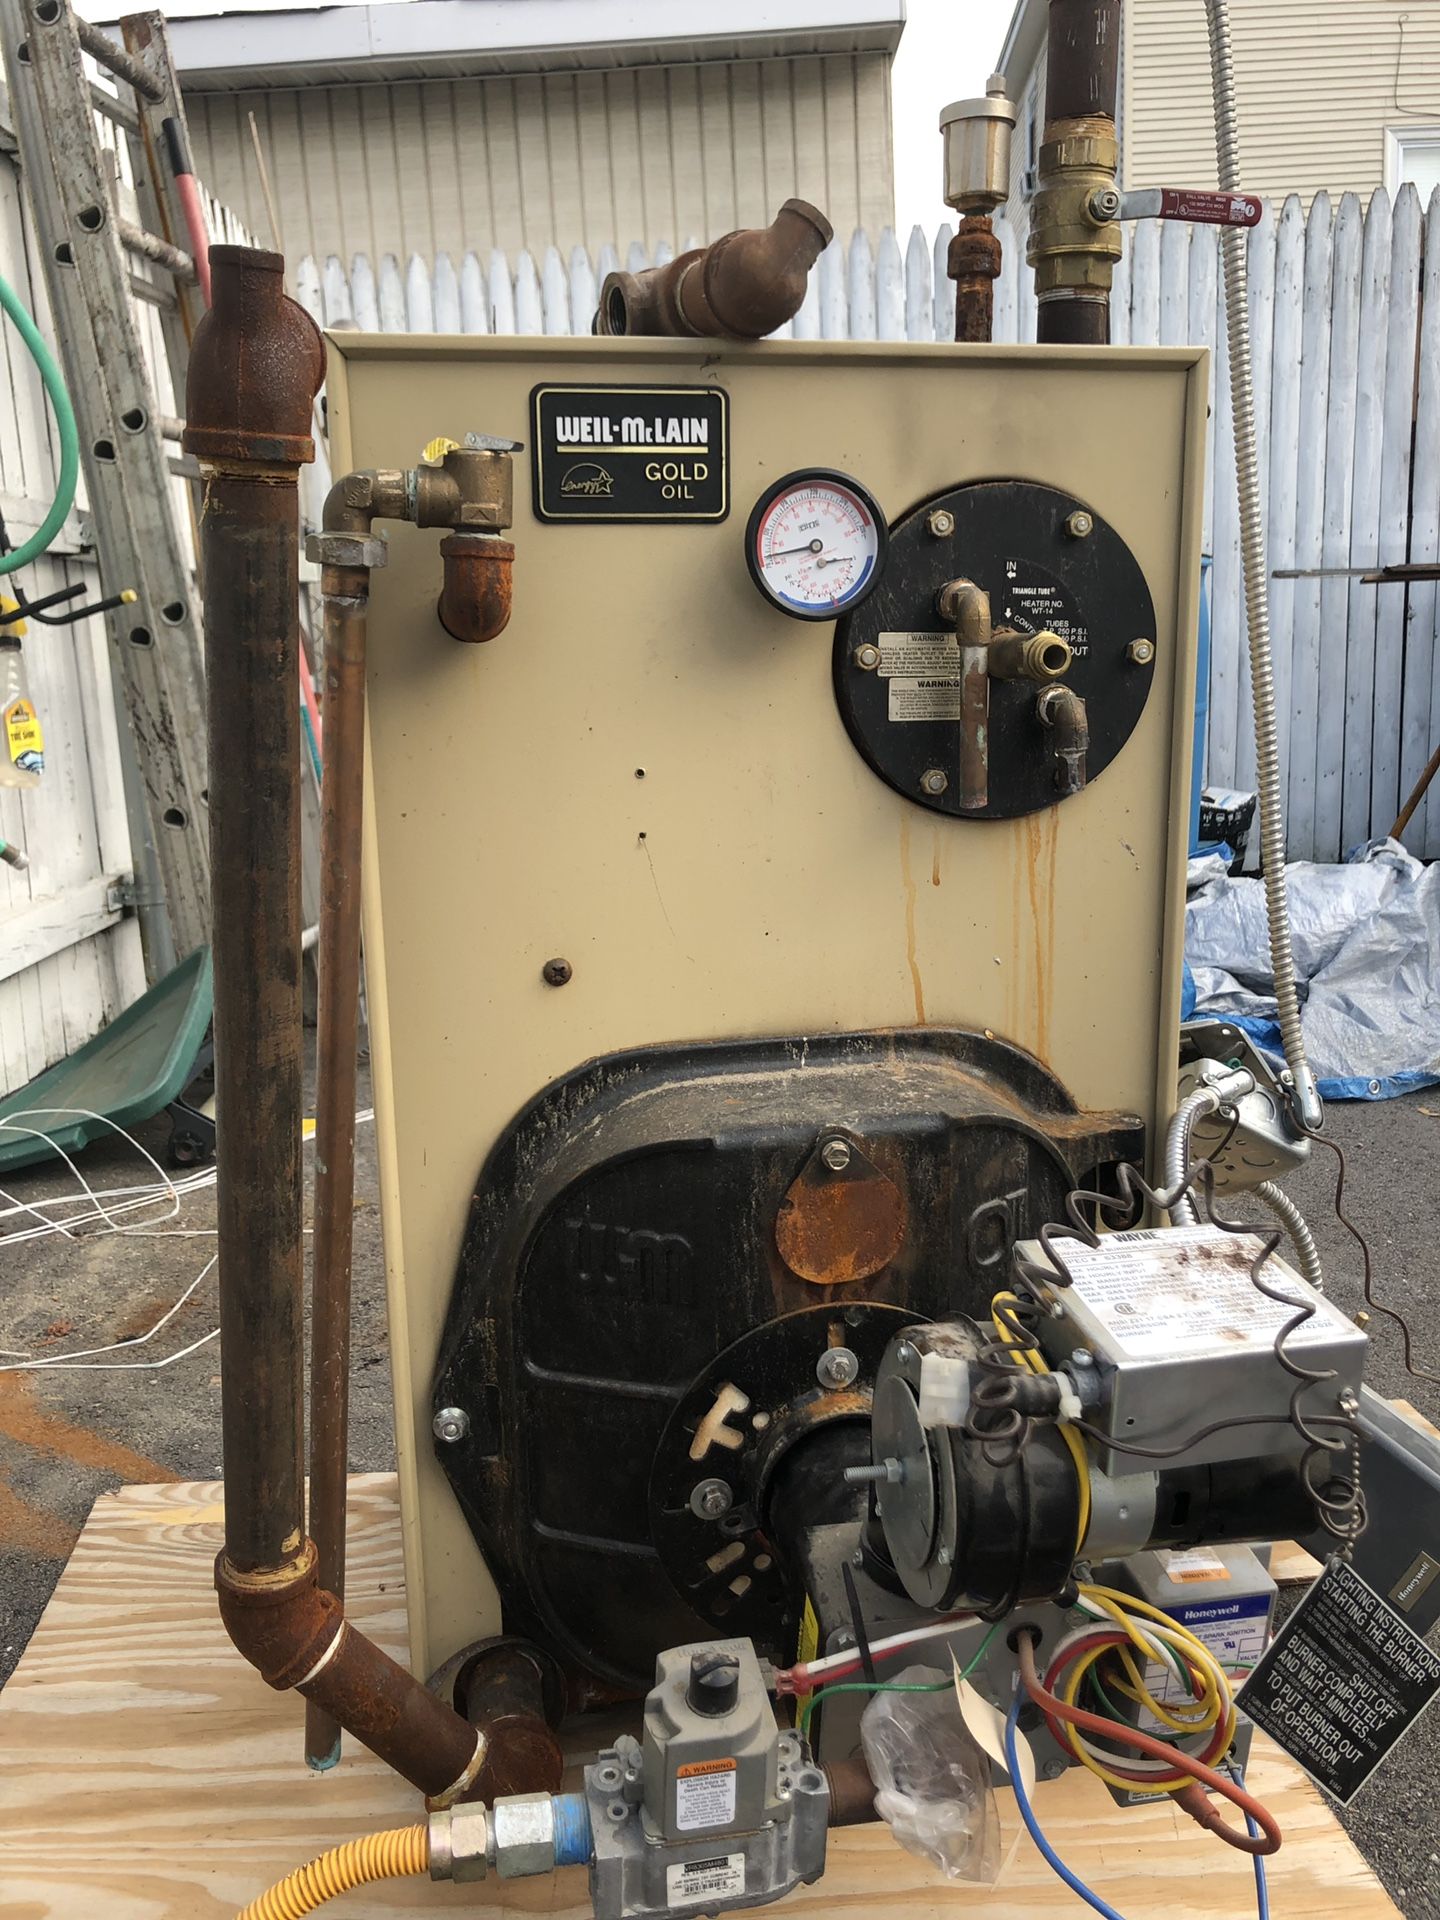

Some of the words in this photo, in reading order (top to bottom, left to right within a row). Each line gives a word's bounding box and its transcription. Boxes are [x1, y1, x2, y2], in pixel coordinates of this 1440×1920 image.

[645, 462, 708, 481] GOLD
[661, 484, 694, 499] OIL
[1006, 561, 1017, 570] IN
[1012, 587, 1037, 595] TRIANGLE
[1051, 600, 1064, 608] NO.
[917, 680, 960, 688] WARNING
[1112, 1231, 1159, 1242] WAYNE
[1397, 1562, 1431, 1602] Honeywell
[1184, 1605, 1240, 1620] Honeywell
[1332, 1564, 1376, 1612] LIGHTING
[1372, 1606, 1440, 1679] INSTRUCTIONS
[1203, 1632, 1225, 1640] SPARK
[1226, 1628, 1256, 1636] IGNITION
[1321, 1575, 1368, 1625] STARTING
[1364, 1619, 1387, 1645] THE
[1383, 1639, 1428, 1686] BURNER:
[1391, 1664, 1398, 1672] TO
[1287, 1635, 1327, 1676] BURNER
[1323, 1670, 1385, 1732] COMPLETELY
[1381, 1677, 1388, 1685] TO
[1277, 1648, 1300, 1673] AND
[1296, 1666, 1323, 1695] WAIT
[1318, 1688, 1329, 1701] 5
[1324, 1694, 1372, 1743] MINUTES,
[1348, 1672, 1377, 1703] SHUT
[1373, 1697, 1397, 1722] OFF
[1265, 1670, 1282, 1690] TO
[1279, 1683, 1302, 1708] PUT
[1298, 1701, 1341, 1745] BURNER
[1337, 1738, 1363, 1764] OUT
[1269, 1696, 1287, 1716] OF
[1283, 1709, 1341, 1765] OPERATION
[693, 1762, 733, 1774] WARNING
